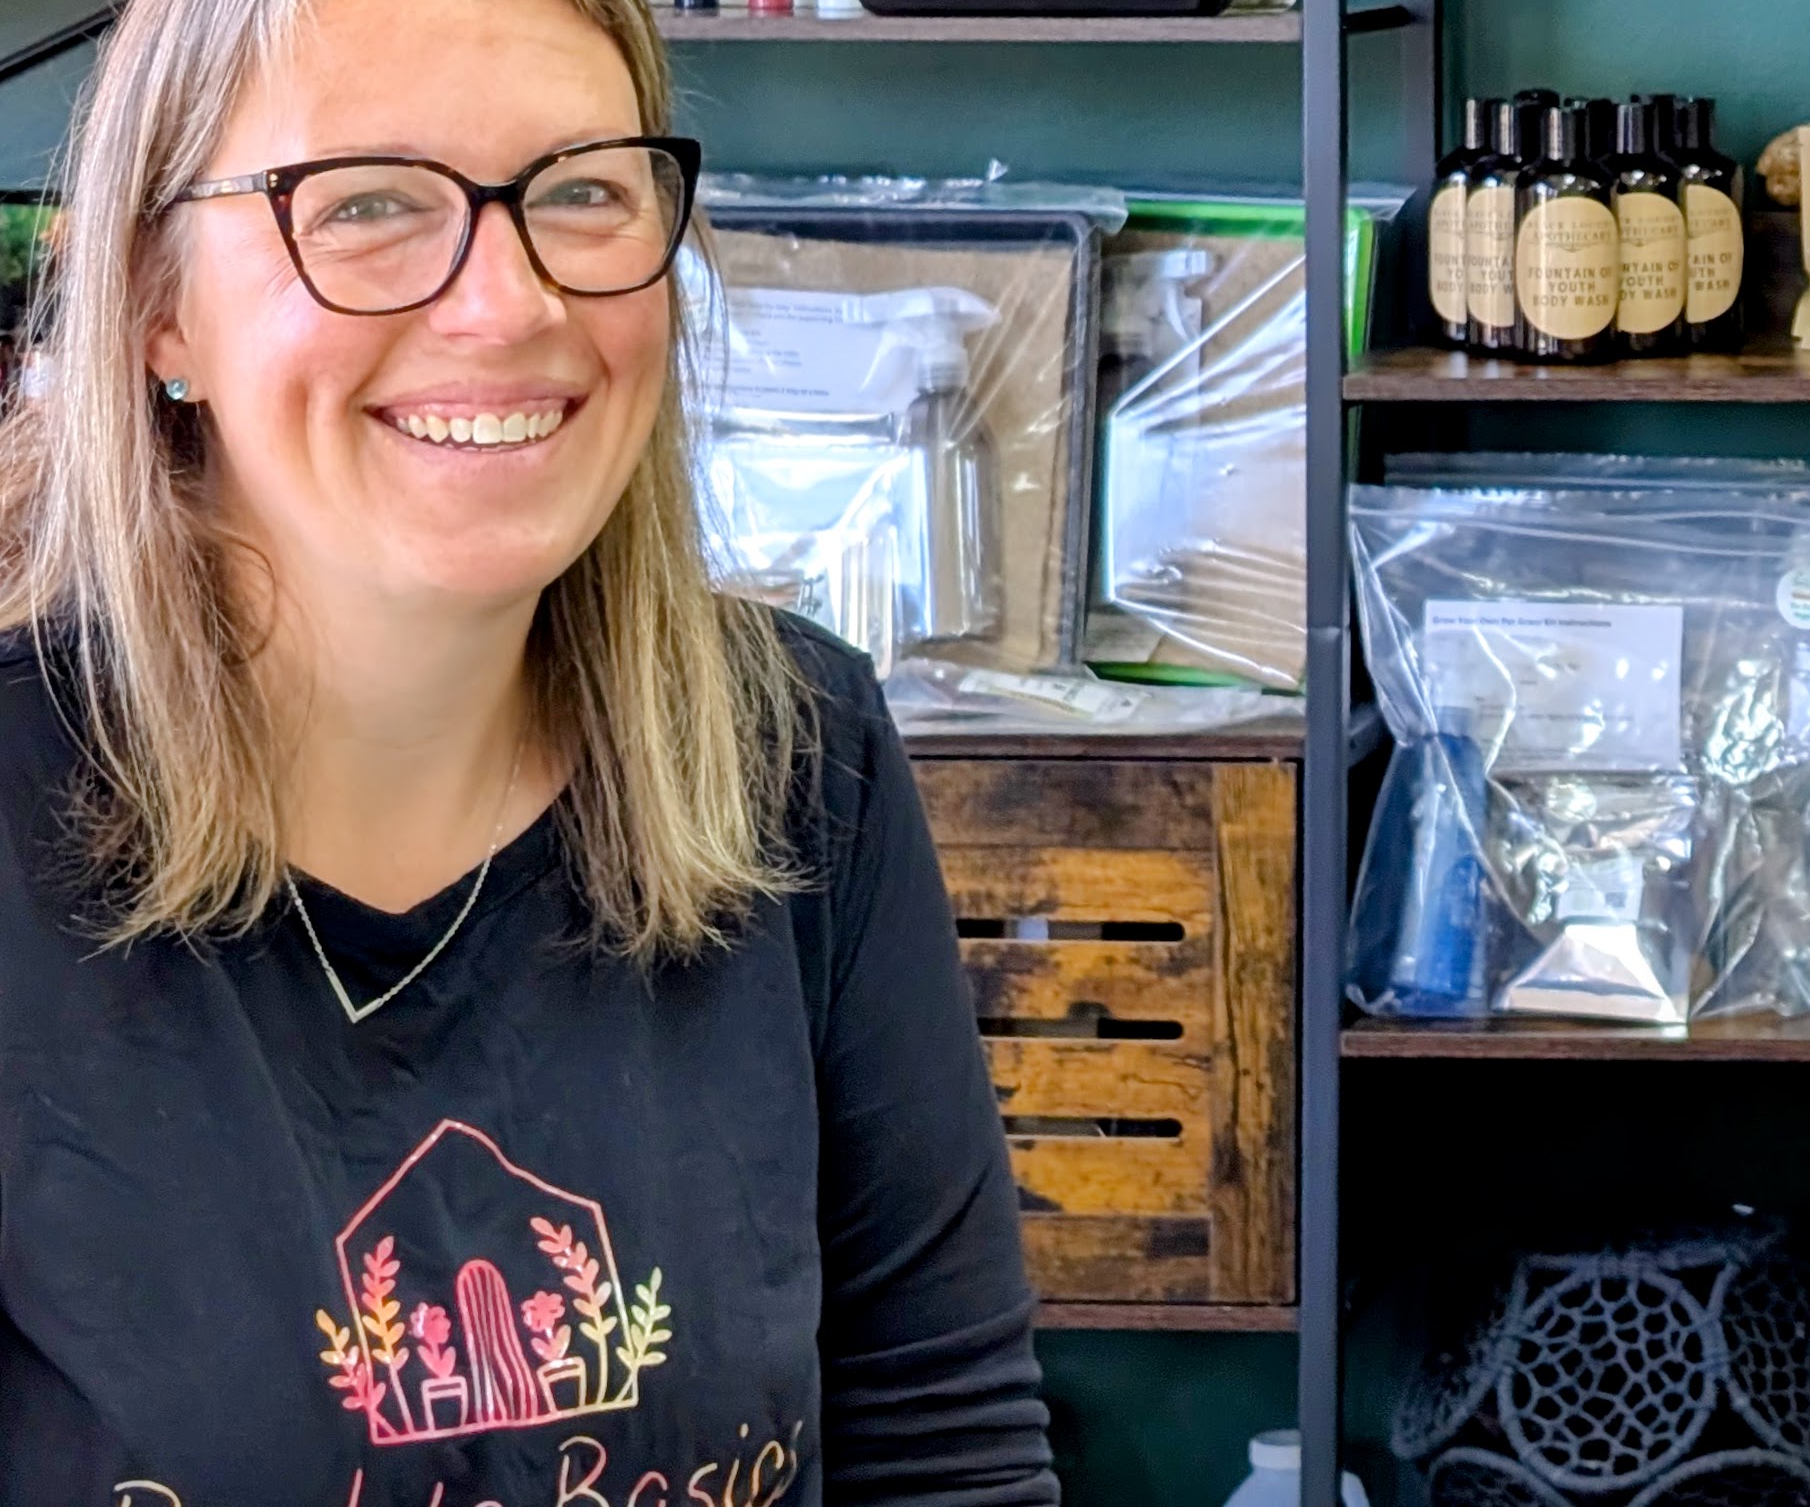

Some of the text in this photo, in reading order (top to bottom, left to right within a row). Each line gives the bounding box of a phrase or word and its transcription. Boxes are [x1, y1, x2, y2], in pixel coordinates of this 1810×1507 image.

[1527, 267, 1596, 279] FOUNTAIN
[1549, 281, 1596, 293] YOUTH
[1642, 287, 1678, 300] WASH
[1532, 295, 1610, 307] BODY WASH
